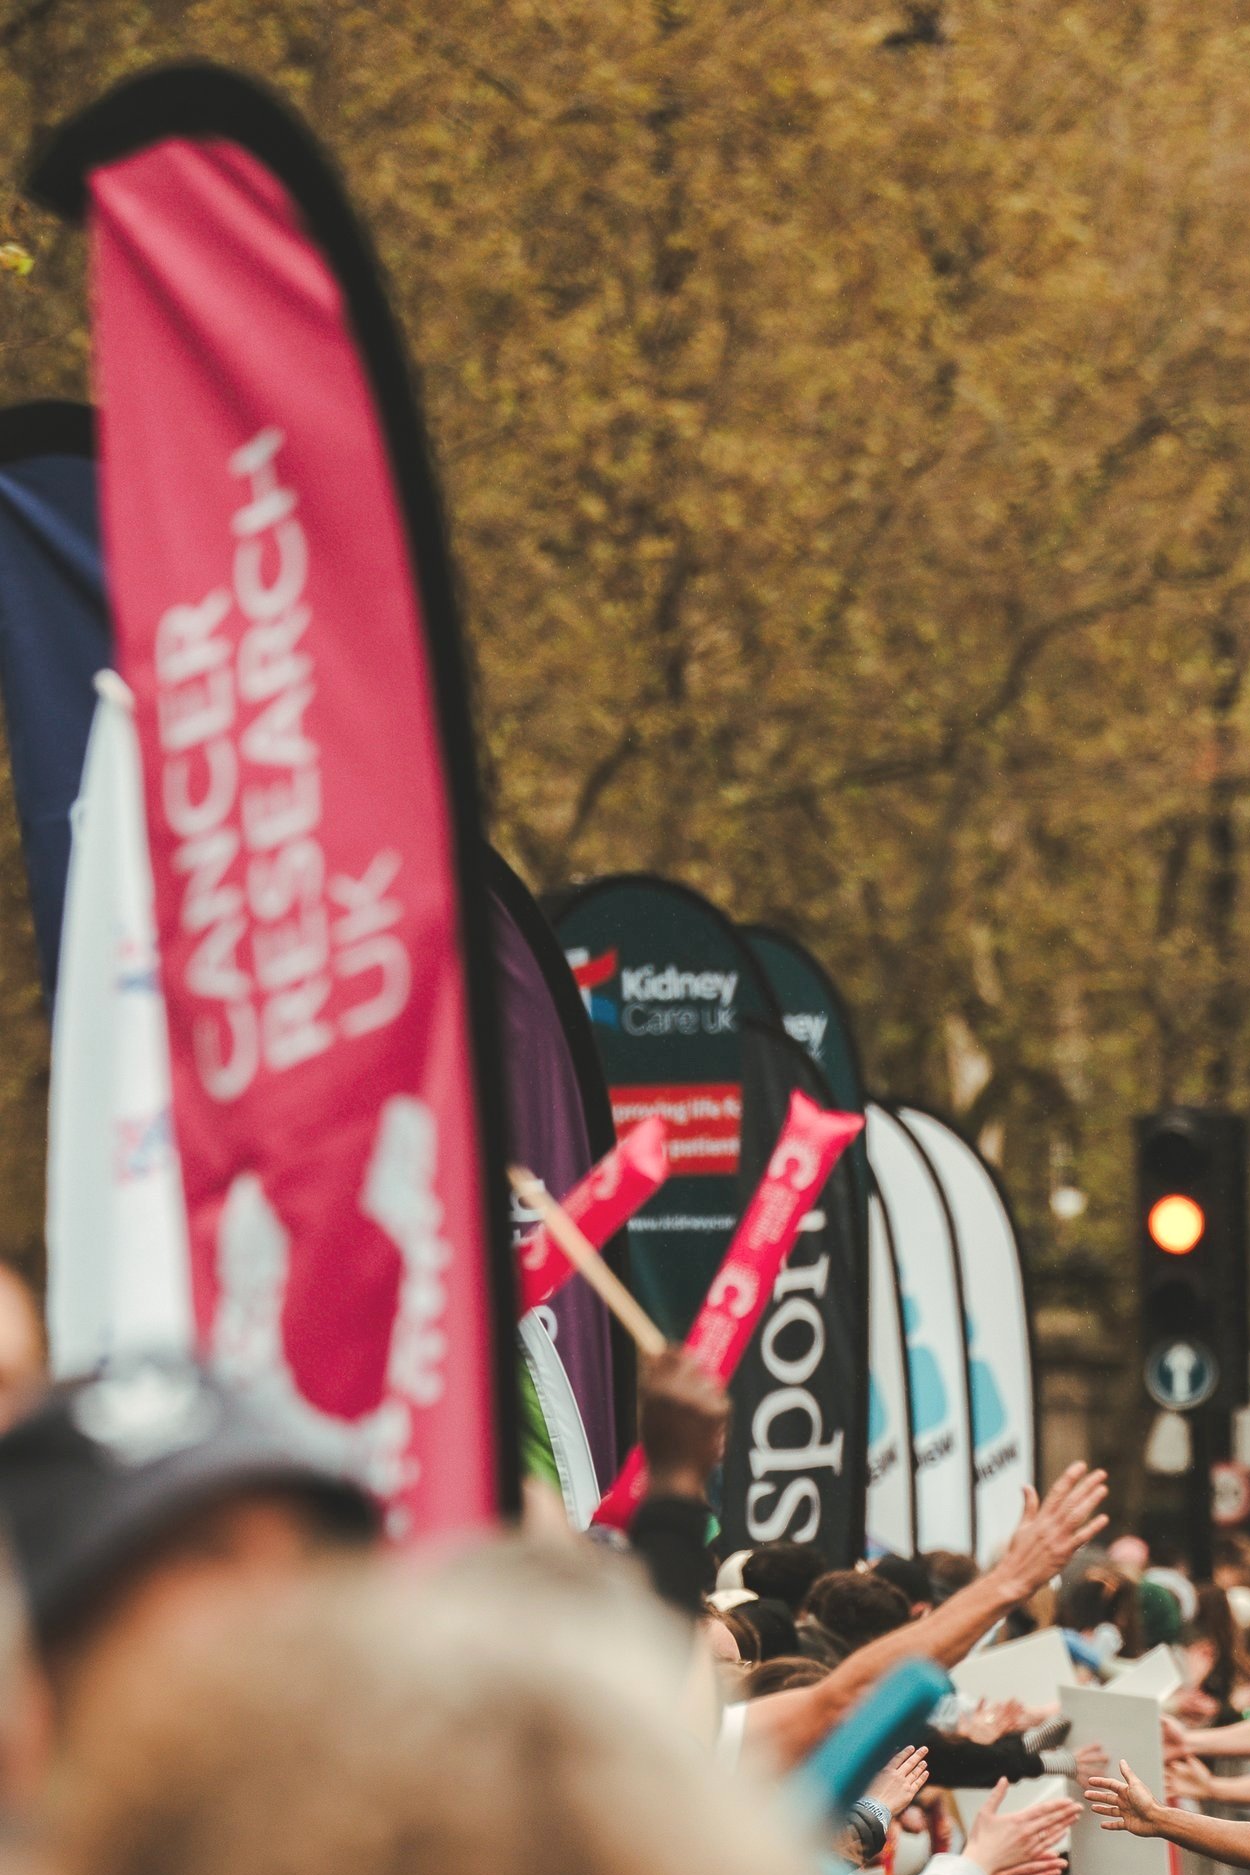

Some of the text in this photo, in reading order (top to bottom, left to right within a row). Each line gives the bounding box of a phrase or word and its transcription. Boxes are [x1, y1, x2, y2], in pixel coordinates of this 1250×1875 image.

[155, 588, 259, 1102] CANCER
[230, 425, 333, 1073] RESEARCH
[335, 847, 412, 1041] UK
[621, 964, 738, 1008] Kidney
[621, 1002, 699, 1036] Care
